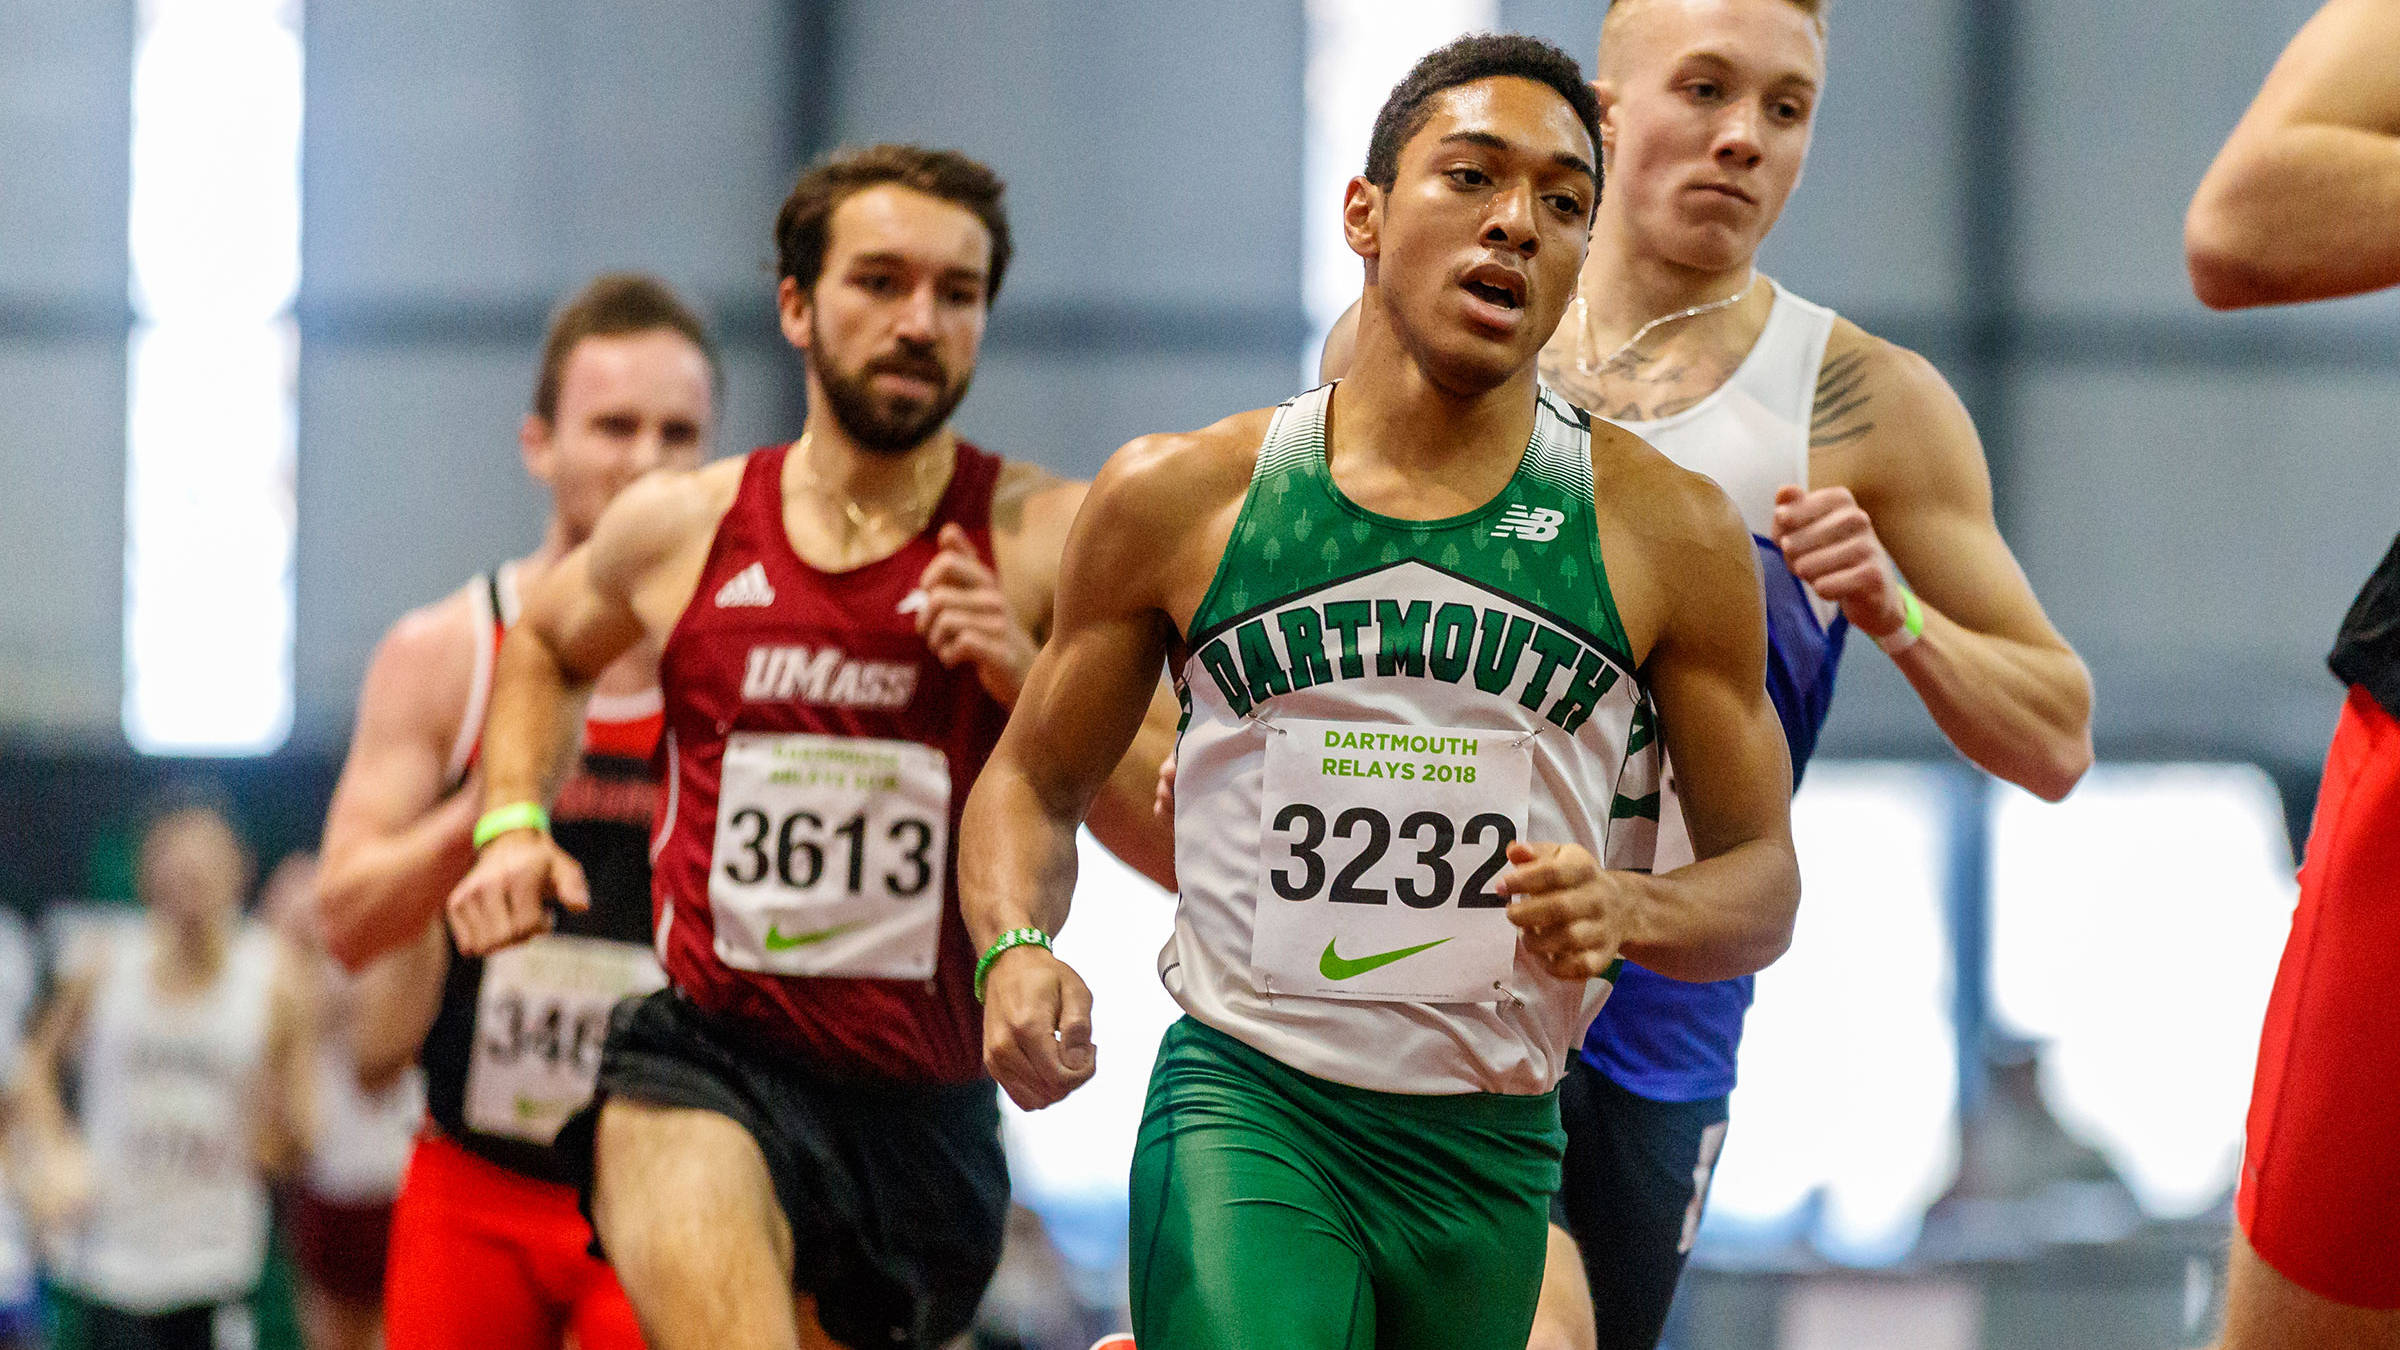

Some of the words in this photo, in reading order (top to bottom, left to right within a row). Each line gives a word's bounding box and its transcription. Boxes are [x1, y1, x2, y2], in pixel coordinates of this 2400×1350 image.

[1199, 599, 1620, 735] DARTMOUTH
[1322, 758, 1415, 780] RELAYS
[1422, 764, 1476, 783] 2018
[1324, 730, 1478, 756] DARTMOUTH
[725, 807, 933, 898] 3613
[1269, 803, 1517, 910] 3232
